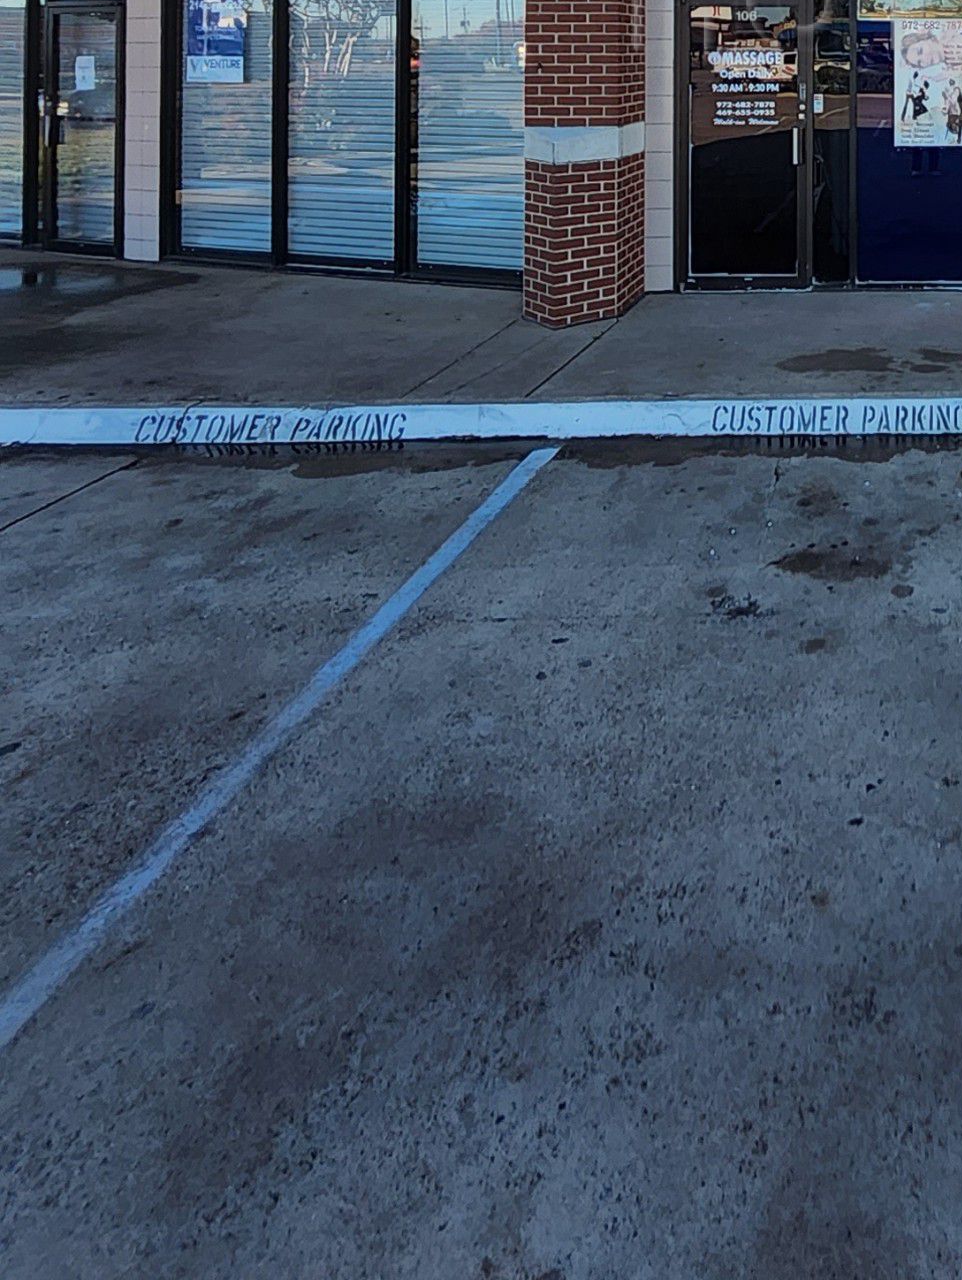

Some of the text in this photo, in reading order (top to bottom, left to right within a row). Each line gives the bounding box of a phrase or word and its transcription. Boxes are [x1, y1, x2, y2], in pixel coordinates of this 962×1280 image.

[204, 58, 241, 69] VENTURE
[721, 51, 782, 66] MASSAGE
[720, 69, 772, 80] Open Daily
[729, 83, 744, 92] AM
[766, 83, 780, 92] PM
[711, 404, 849, 433] CUSTOMER
[134, 412, 407, 443] CUSTOMER PARKING
